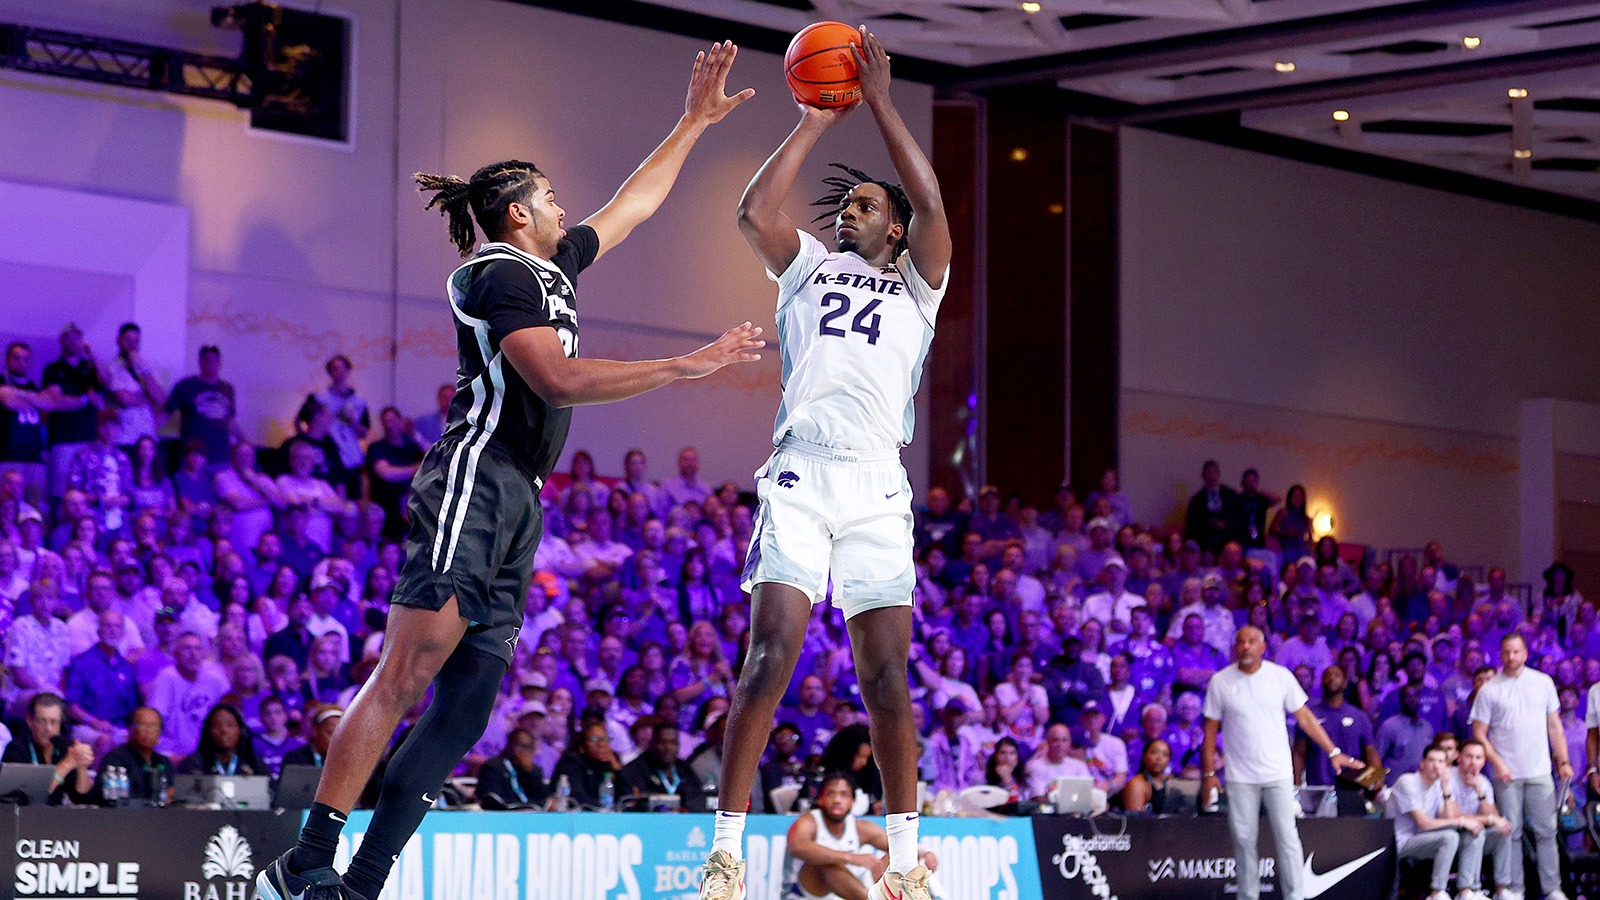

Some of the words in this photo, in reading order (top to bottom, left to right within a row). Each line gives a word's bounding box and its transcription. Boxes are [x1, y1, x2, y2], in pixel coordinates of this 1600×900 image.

[813, 273, 903, 296] K-STATE
[819, 292, 883, 346] 24
[834, 454, 859, 463] FAMILY
[15, 839, 80, 859] CLEAN
[14, 861, 140, 895] SIMPLE
[433, 832, 520, 900] MAR
[526, 832, 642, 900] HOOPS
